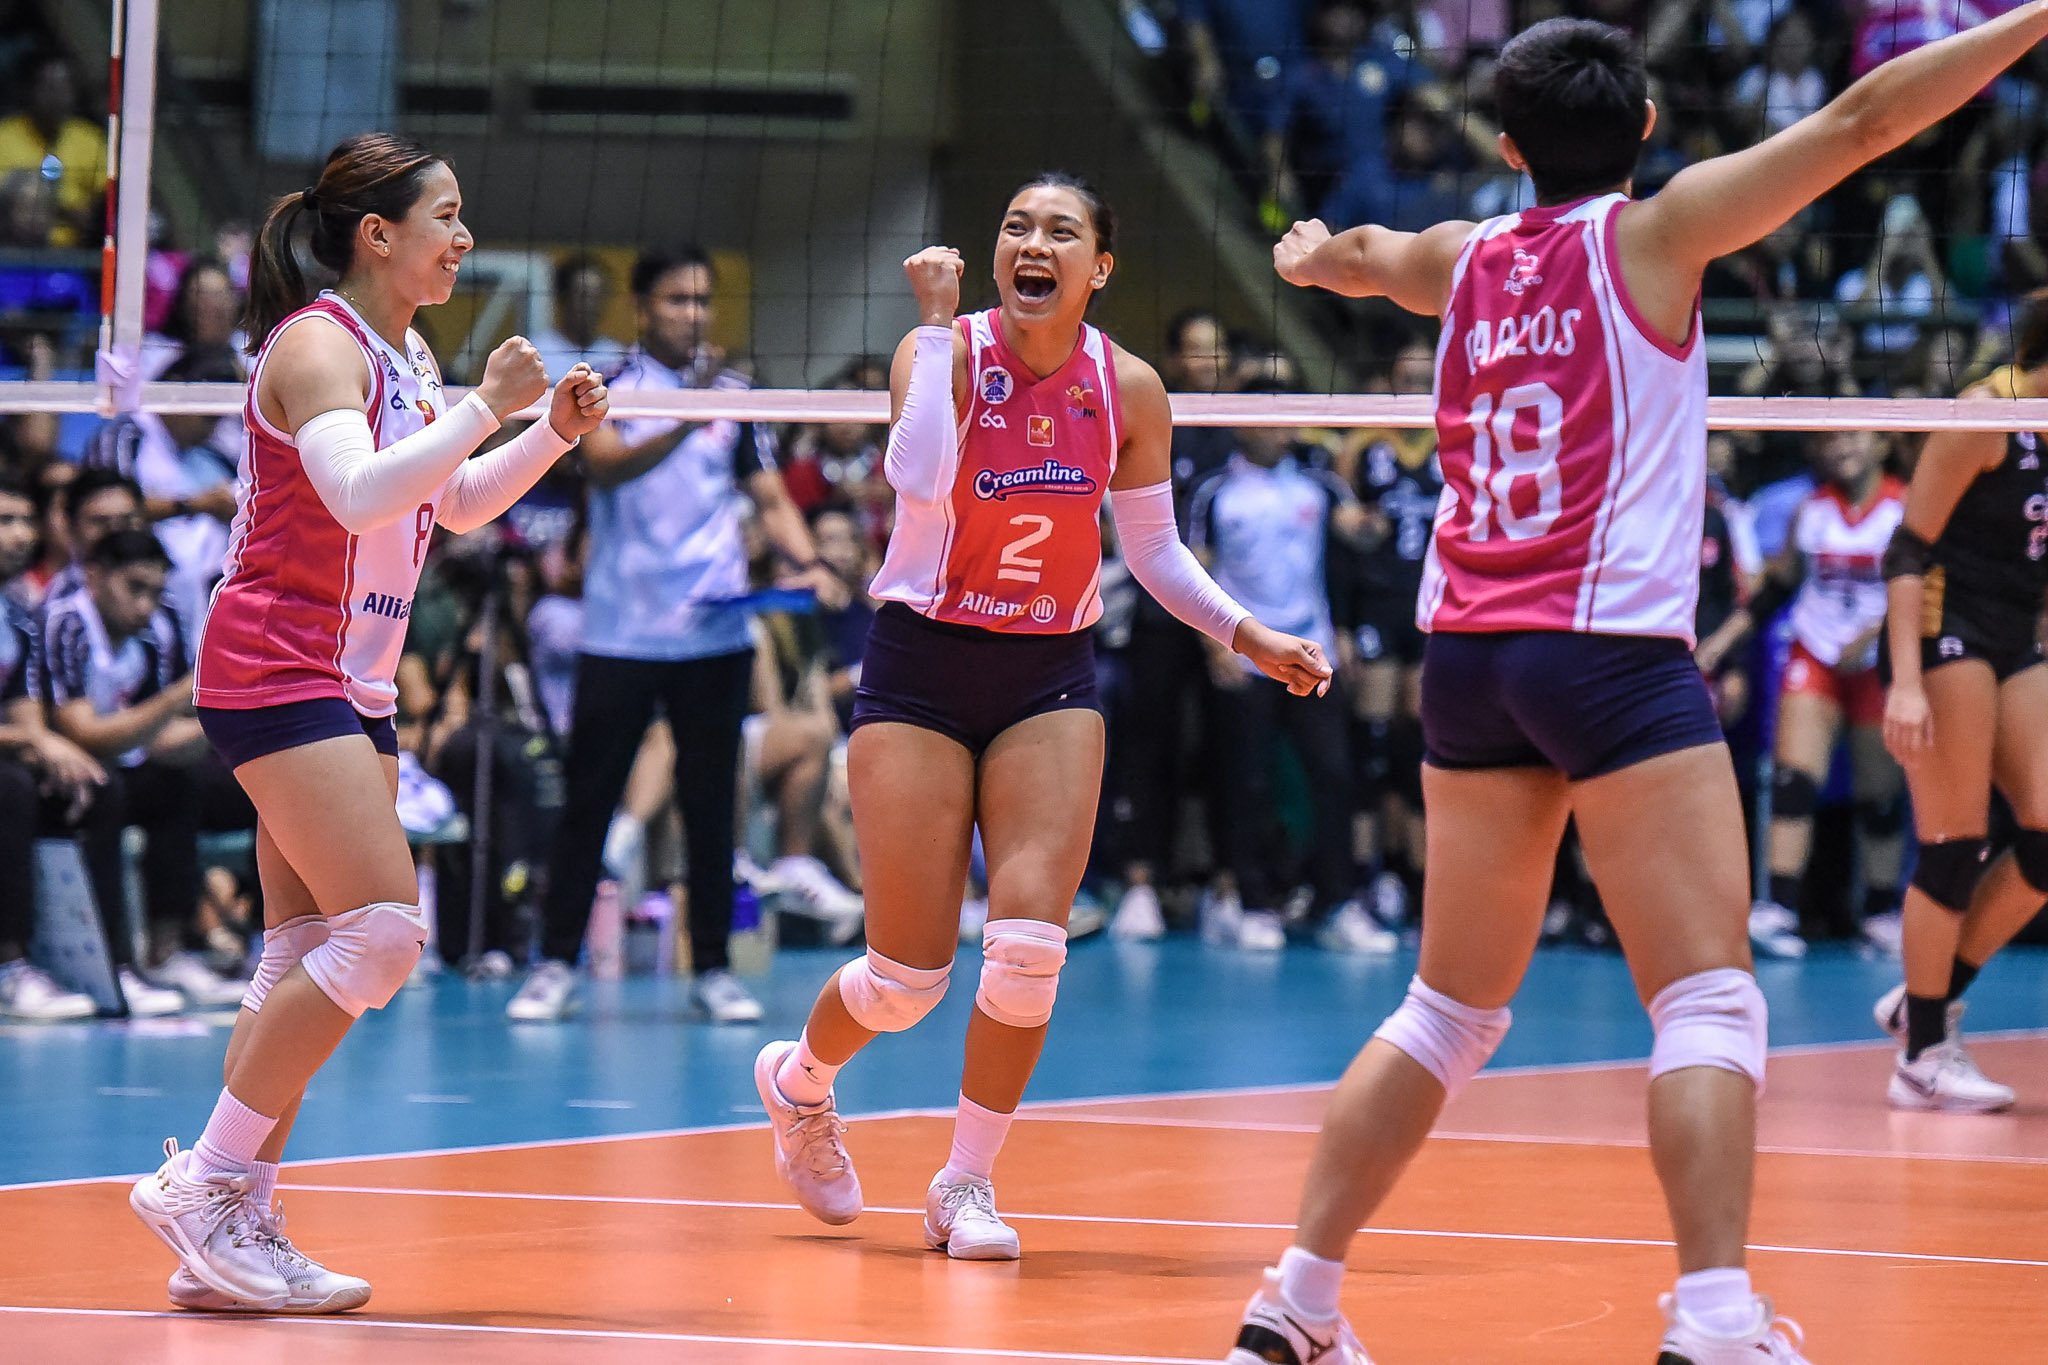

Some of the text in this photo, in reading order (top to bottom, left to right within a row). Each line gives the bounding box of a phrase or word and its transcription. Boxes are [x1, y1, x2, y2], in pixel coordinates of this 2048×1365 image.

[974, 460, 1083, 499] Creamline
[1465, 382, 1564, 542] 18
[999, 513, 1054, 568] 2
[958, 590, 1030, 617] Allianz
